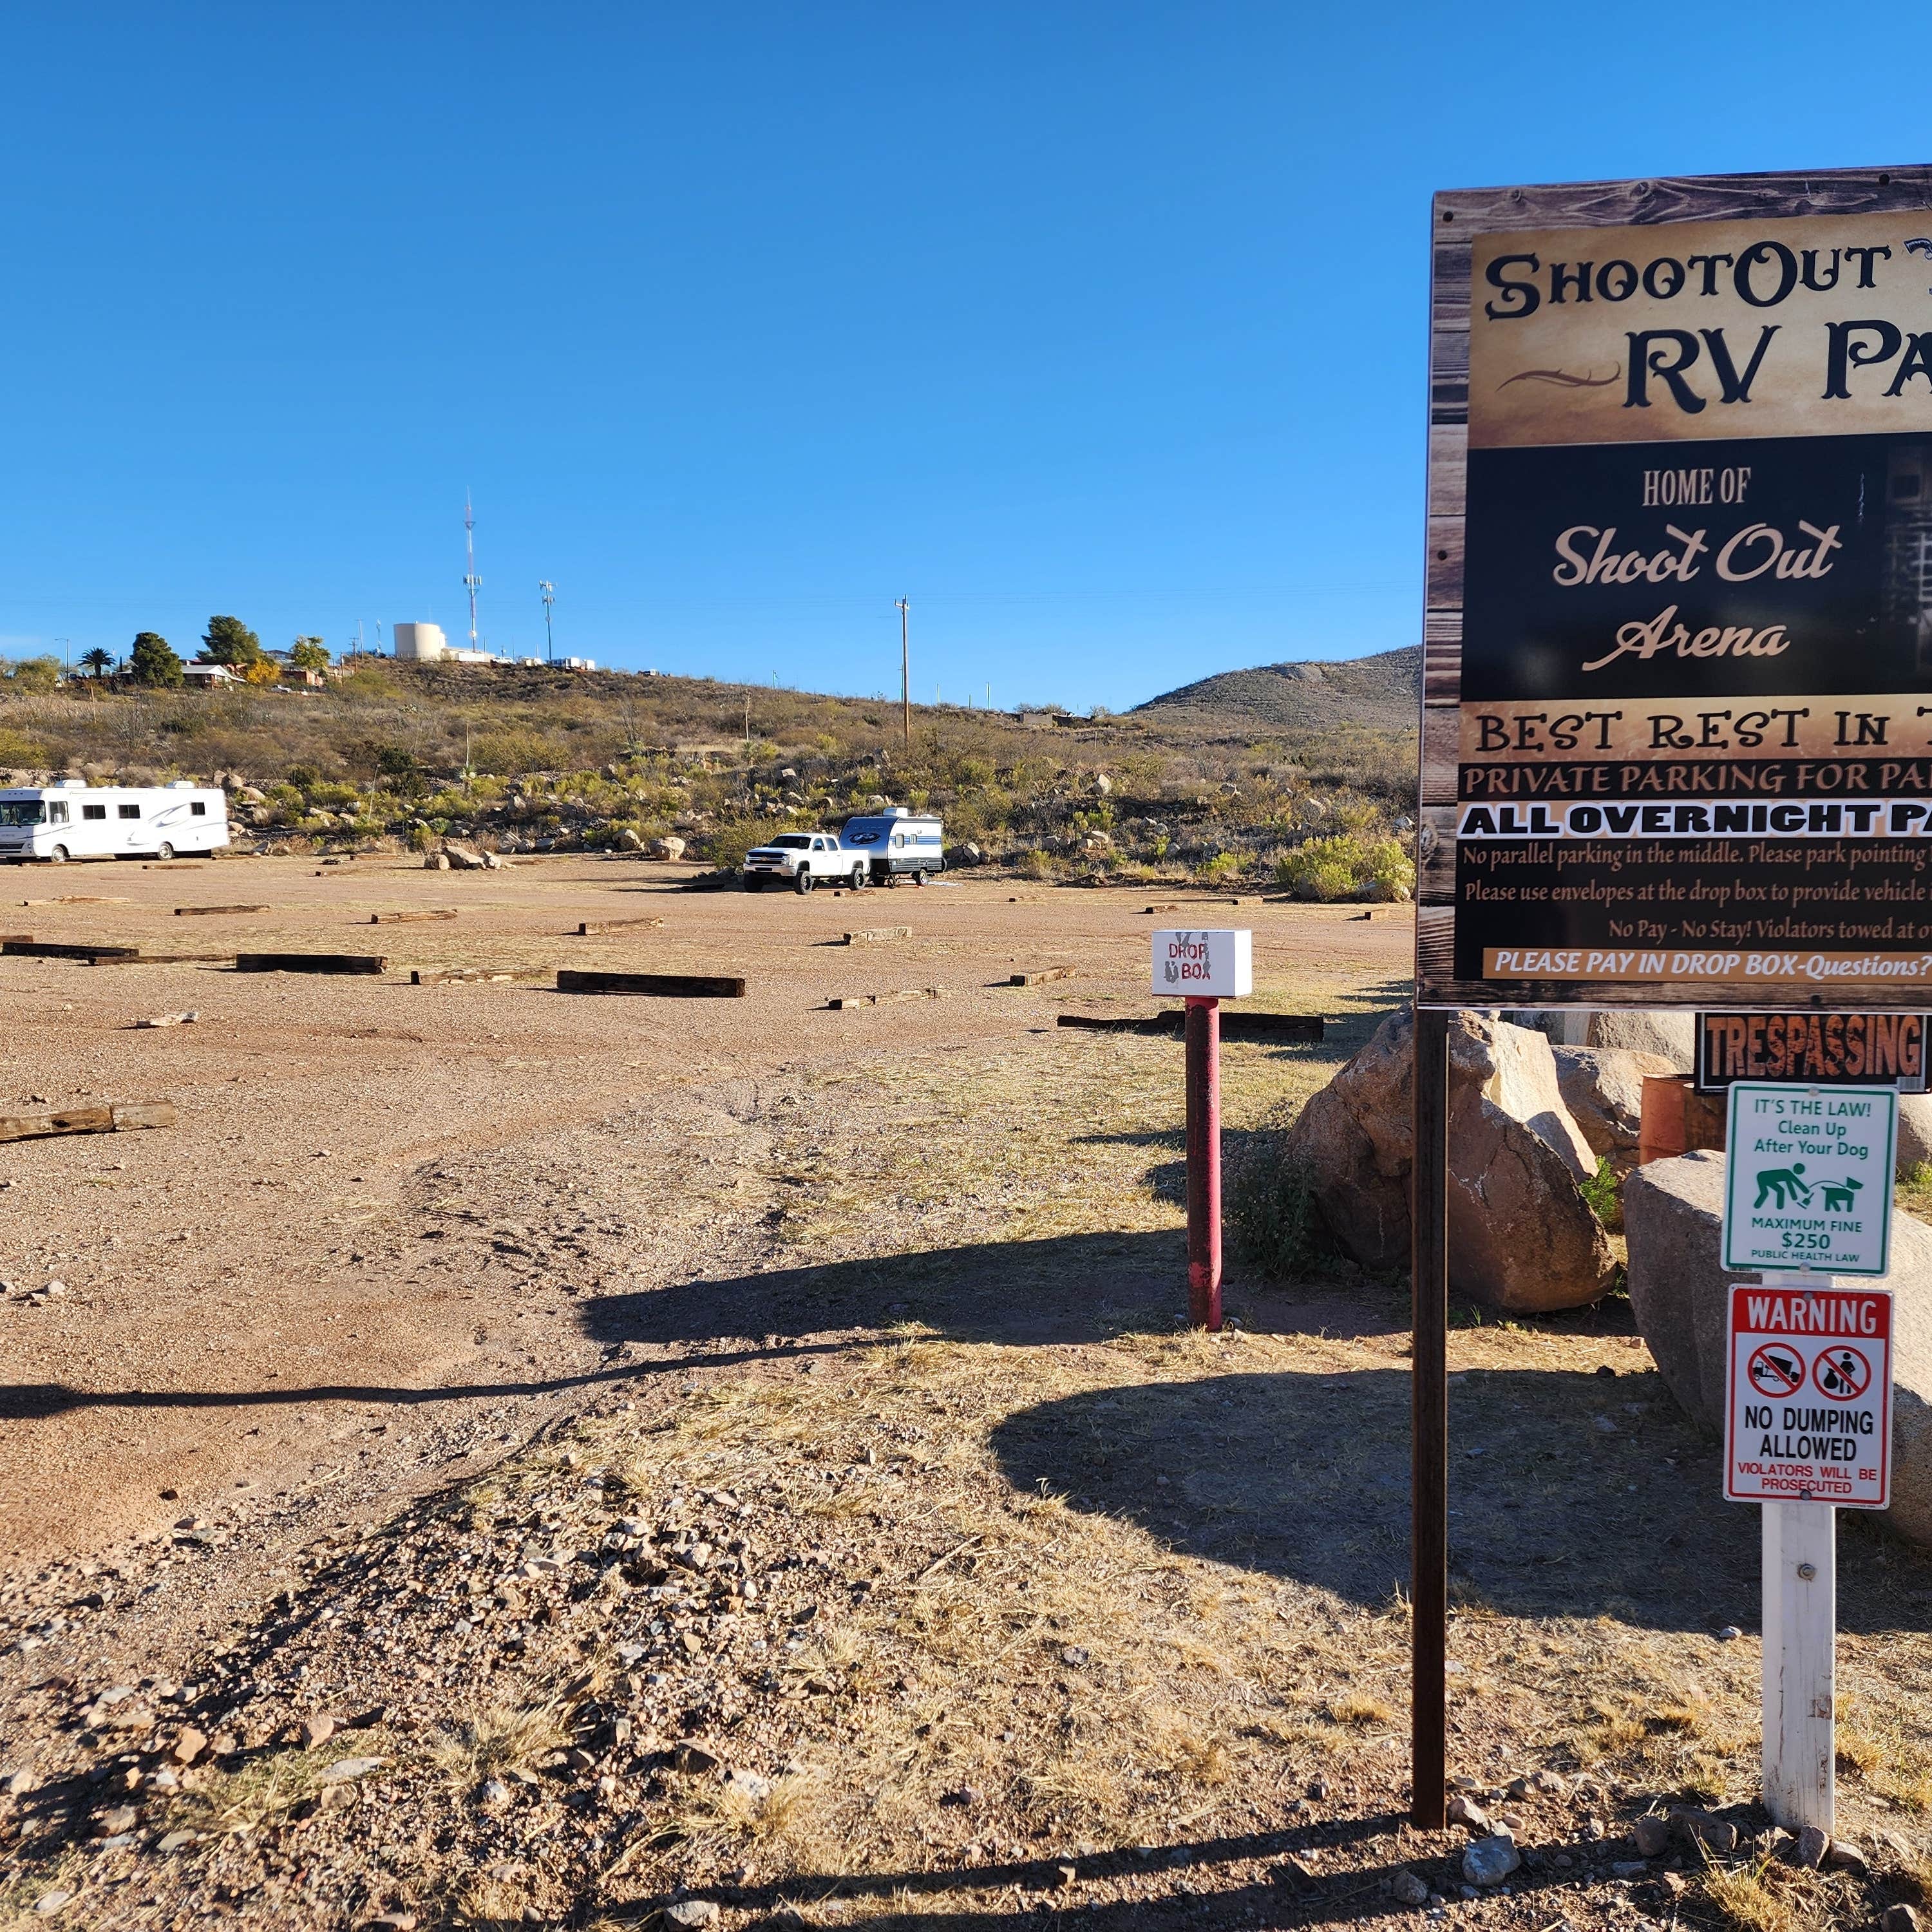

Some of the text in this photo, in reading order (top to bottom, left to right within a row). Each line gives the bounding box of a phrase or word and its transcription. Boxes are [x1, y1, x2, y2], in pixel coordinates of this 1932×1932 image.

[1622, 325, 1783, 414] RV
[1642, 468, 1752, 507] HOME OF
[1553, 520, 1842, 586] Shoot Out
[1582, 605, 1790, 672] Arena
[1475, 710, 1623, 752] BEST
[1647, 708, 1810, 750] REST
[1833, 711, 1891, 746] IN
[1464, 762, 1932, 794] PRIVATE PARKING FOR PA
[1461, 804, 1932, 835] ALL OVERNIGHT P
[1463, 847, 1486, 864] No
[1491, 842, 1553, 872] parallel
[1557, 842, 1623, 872] parking
[1626, 844, 1643, 864] in
[1647, 842, 1674, 863] the
[1678, 842, 1744, 863] middle.
[1748, 842, 1803, 863] Please
[1806, 841, 1846, 871] park
[1850, 843, 1927, 871] pointing
[1465, 879, 1517, 900] Please
[1520, 886, 1549, 900] use
[1552, 879, 1634, 908] envelopes
[1638, 884, 1655, 900] at
[1658, 878, 1686, 900] the
[1689, 878, 1731, 908] drop
[1735, 878, 1767, 900] box
[1771, 884, 1789, 900] to
[1792, 878, 1861, 908] provide
[1864, 878, 1926, 901] vehicle
[1609, 920, 1634, 938] No
[1638, 920, 1668, 945] Pay
[1681, 920, 1707, 938] No
[1709, 920, 1752, 945] Stay!
[1756, 916, 1835, 938] Violators
[1839, 916, 1893, 938] towed
[1897, 921, 1915, 938] at
[1495, 951, 1582, 972] PLEASE
[1586, 952, 1635, 973] PAY
[1638, 953, 1667, 974] IN
[1671, 953, 1741, 975] DROP
[1707, 1015, 1920, 1077] TRESPASSING
[1755, 1099, 1871, 1117] IT'S THE LAW!
[1778, 1120, 1847, 1139] Clean Up
[1754, 1139, 1869, 1160] After Your Dog
[1752, 1217, 1863, 1233] MAXIMUM FINE
[1781, 1231, 1831, 1249] $250
[1751, 1249, 1860, 1262] PUBLIC HEALTH LAW
[1747, 1296, 1877, 1334] WARNING
[1745, 1405, 1874, 1435] NO DUMPING
[1759, 1434, 1857, 1462] ALLOWED
[1738, 1463, 1877, 1481] VIOLATORS WILL BE
[1761, 1478, 1853, 1494] PROSECUTED
